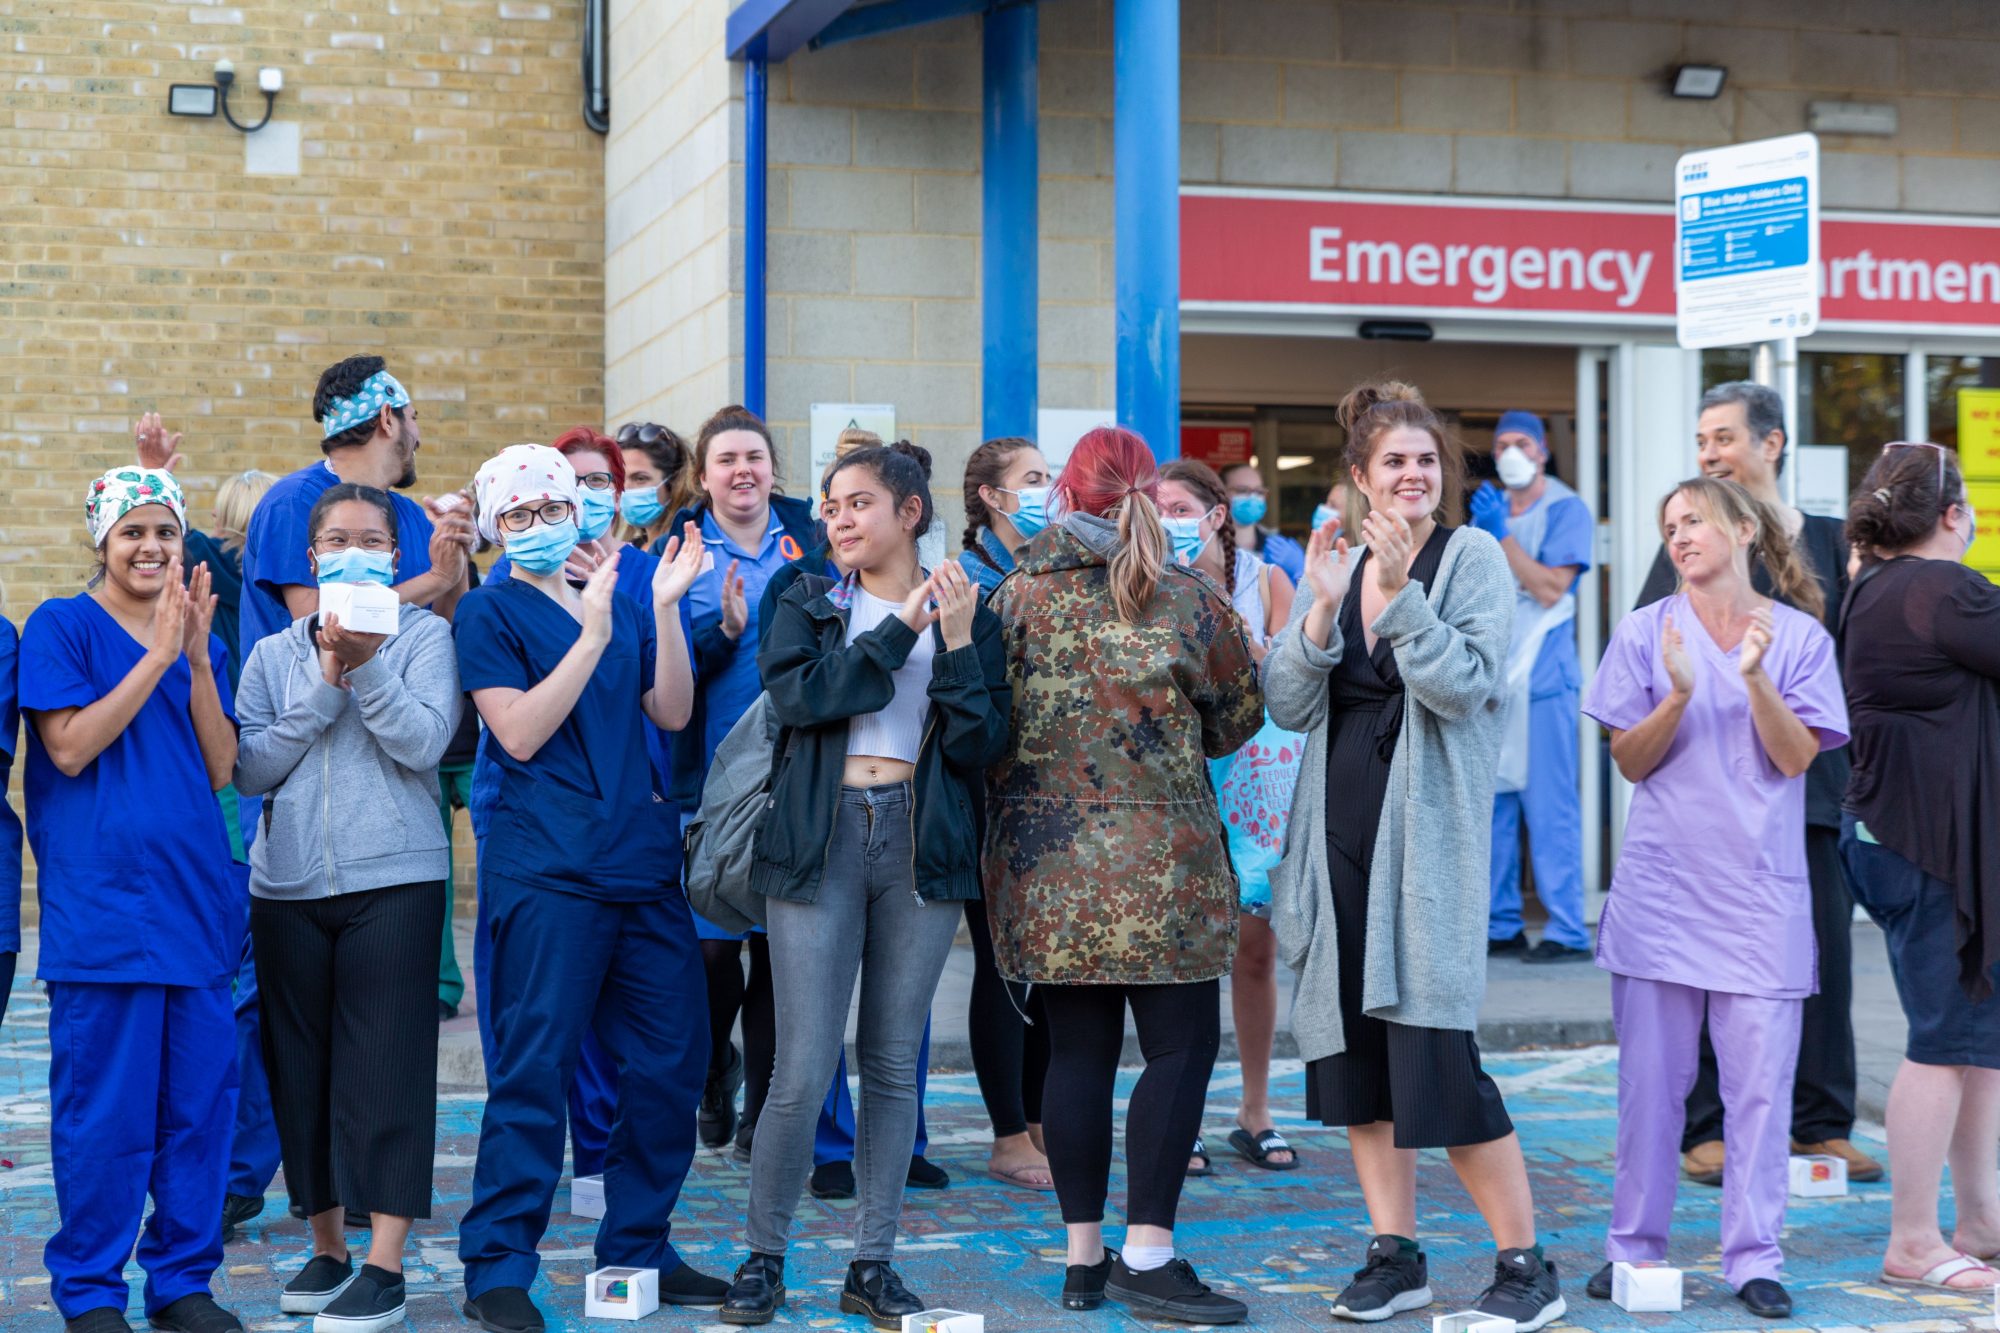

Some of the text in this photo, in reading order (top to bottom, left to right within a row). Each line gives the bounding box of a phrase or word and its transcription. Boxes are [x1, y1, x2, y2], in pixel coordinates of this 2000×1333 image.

[1309, 227, 1653, 307] Emergency
[1819, 249, 2000, 304] rtmen
[1262, 767, 1297, 782] REDUCE
